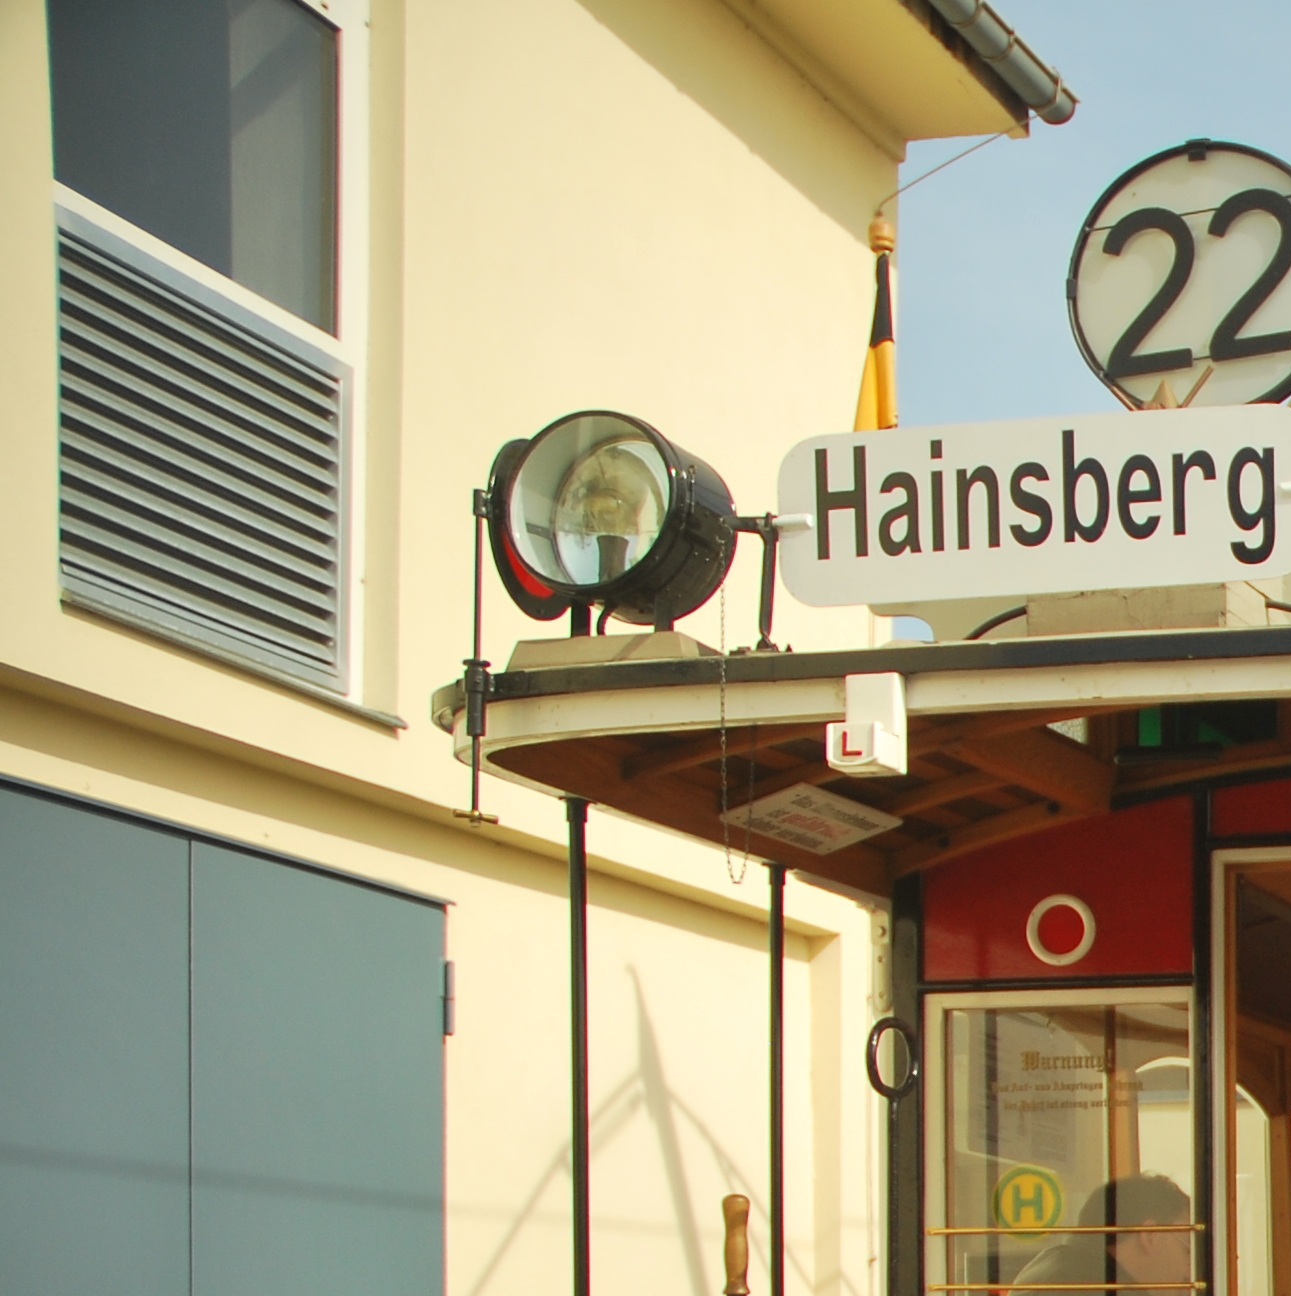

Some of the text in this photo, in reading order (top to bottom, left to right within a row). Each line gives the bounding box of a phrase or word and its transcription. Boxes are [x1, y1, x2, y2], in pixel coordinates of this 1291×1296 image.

[812, 428, 1277, 567] Hainsberg
[842, 730, 862, 757] L
[1012, 1182, 1043, 1223] H
